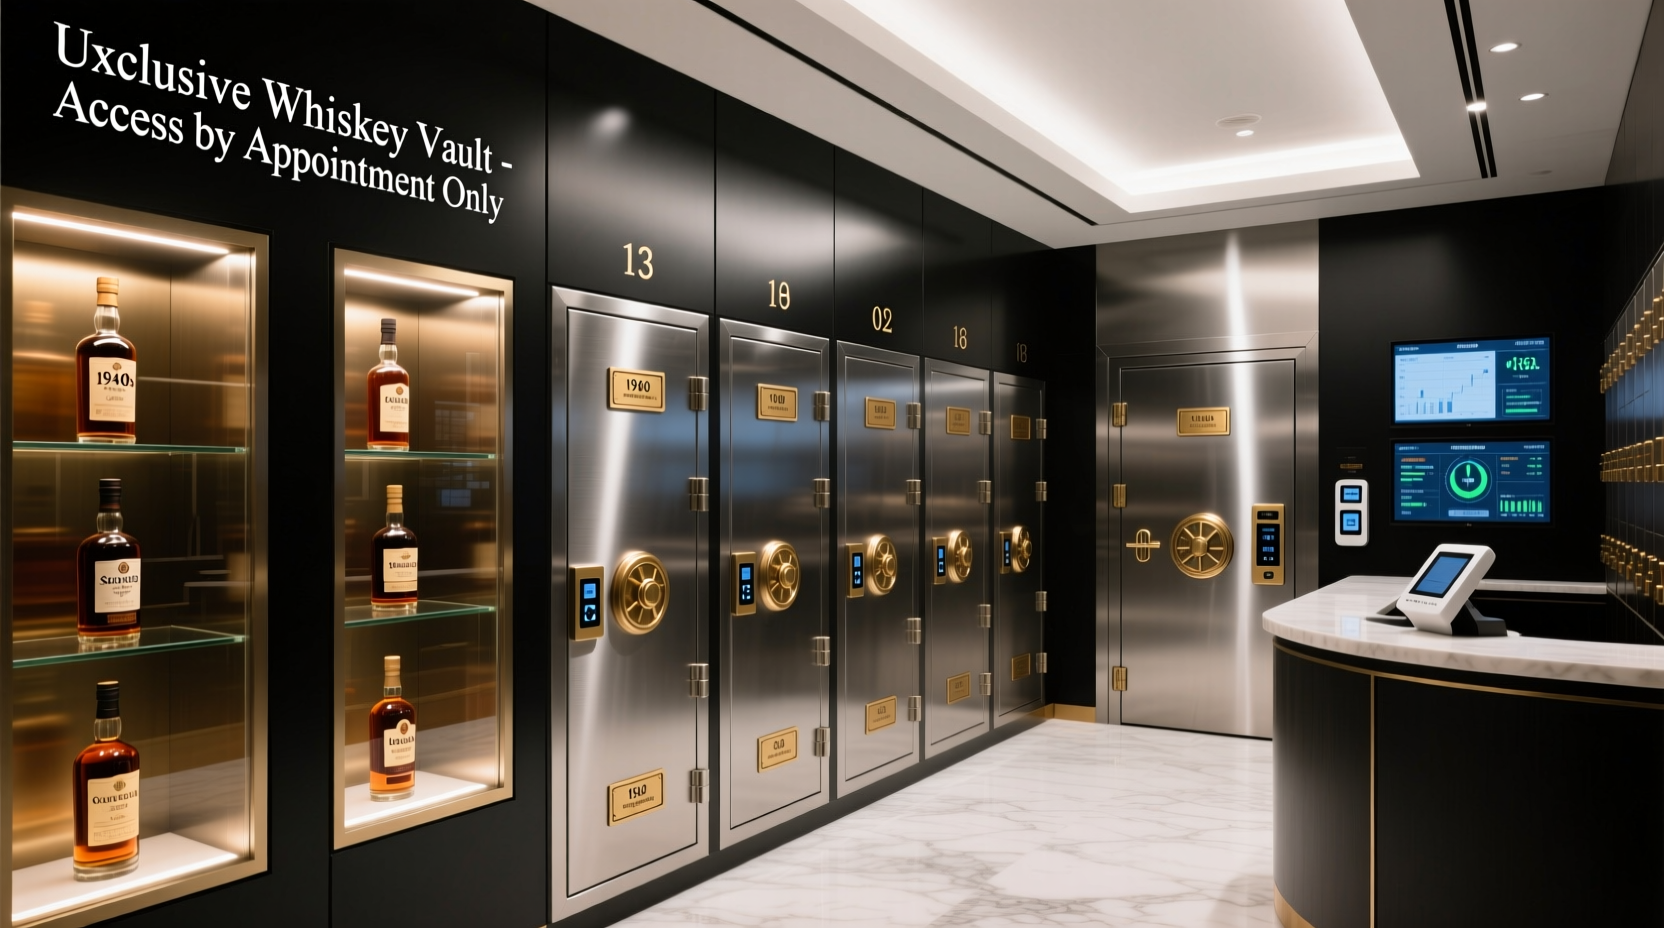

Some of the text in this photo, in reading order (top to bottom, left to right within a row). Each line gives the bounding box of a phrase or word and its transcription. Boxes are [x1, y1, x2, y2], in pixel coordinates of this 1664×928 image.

[53, 20, 251, 111] Uxclusive
[262, 77, 409, 159] Whiskey
[416, 120, 493, 174] Vault
[53, 80, 505, 225] Access by Appointment Only
[623, 242, 654, 281] 13
[872, 305, 893, 334] 02
[952, 324, 969, 351] 18
